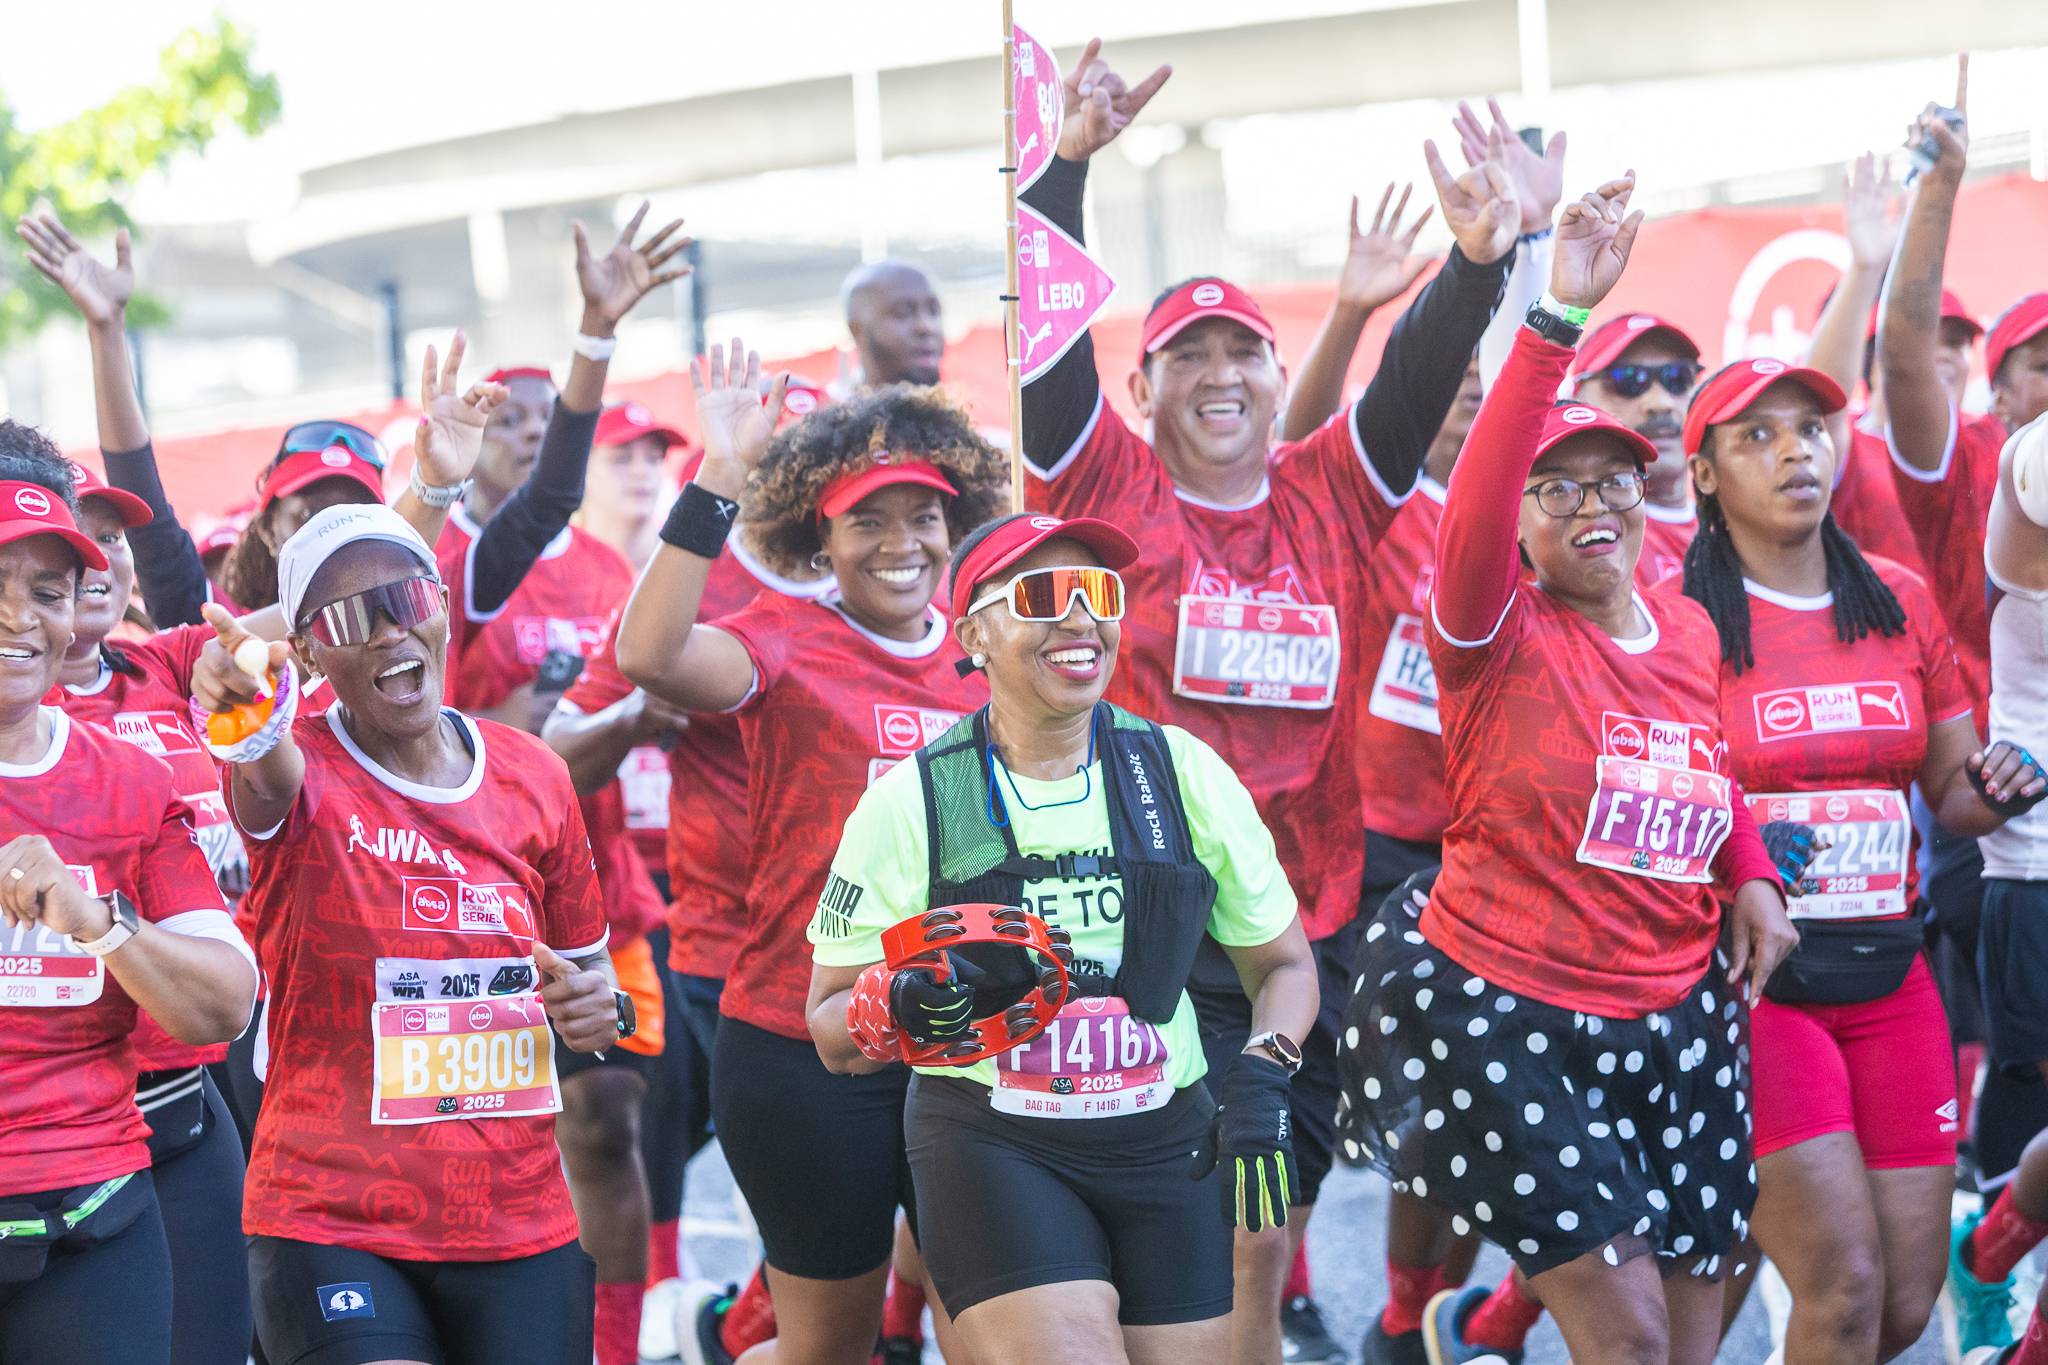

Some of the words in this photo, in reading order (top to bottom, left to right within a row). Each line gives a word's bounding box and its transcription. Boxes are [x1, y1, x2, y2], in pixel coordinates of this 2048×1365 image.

[1038, 282, 1085, 312] LEBO
[1218, 629, 1331, 683] 22502
[119, 721, 150, 736] RUN
[1652, 728, 1686, 746] RUN
[1129, 753, 1155, 805] Rabbit
[1601, 791, 1634, 842] F
[1635, 796, 1729, 857] 15117
[371, 827, 468, 875] JWAA
[417, 896, 446, 910] absa
[462, 887, 500, 904] RUN
[398, 972, 420, 981] ASA
[392, 986, 425, 999] WPA
[428, 1011, 447, 1020] RUN
[402, 1039, 430, 1095] B
[437, 1029, 535, 1093] 3909
[1052, 1079, 1073, 1088] ASA
[1079, 1073, 1124, 1092] 2025
[439, 1101, 457, 1109] ASA
[463, 1094, 505, 1111] 2025
[1025, 1099, 1042, 1111] BAG
[1044, 1101, 1061, 1113] TAG
[1084, 1101, 1091, 1113] F
[1096, 1099, 1121, 1112] 14167
